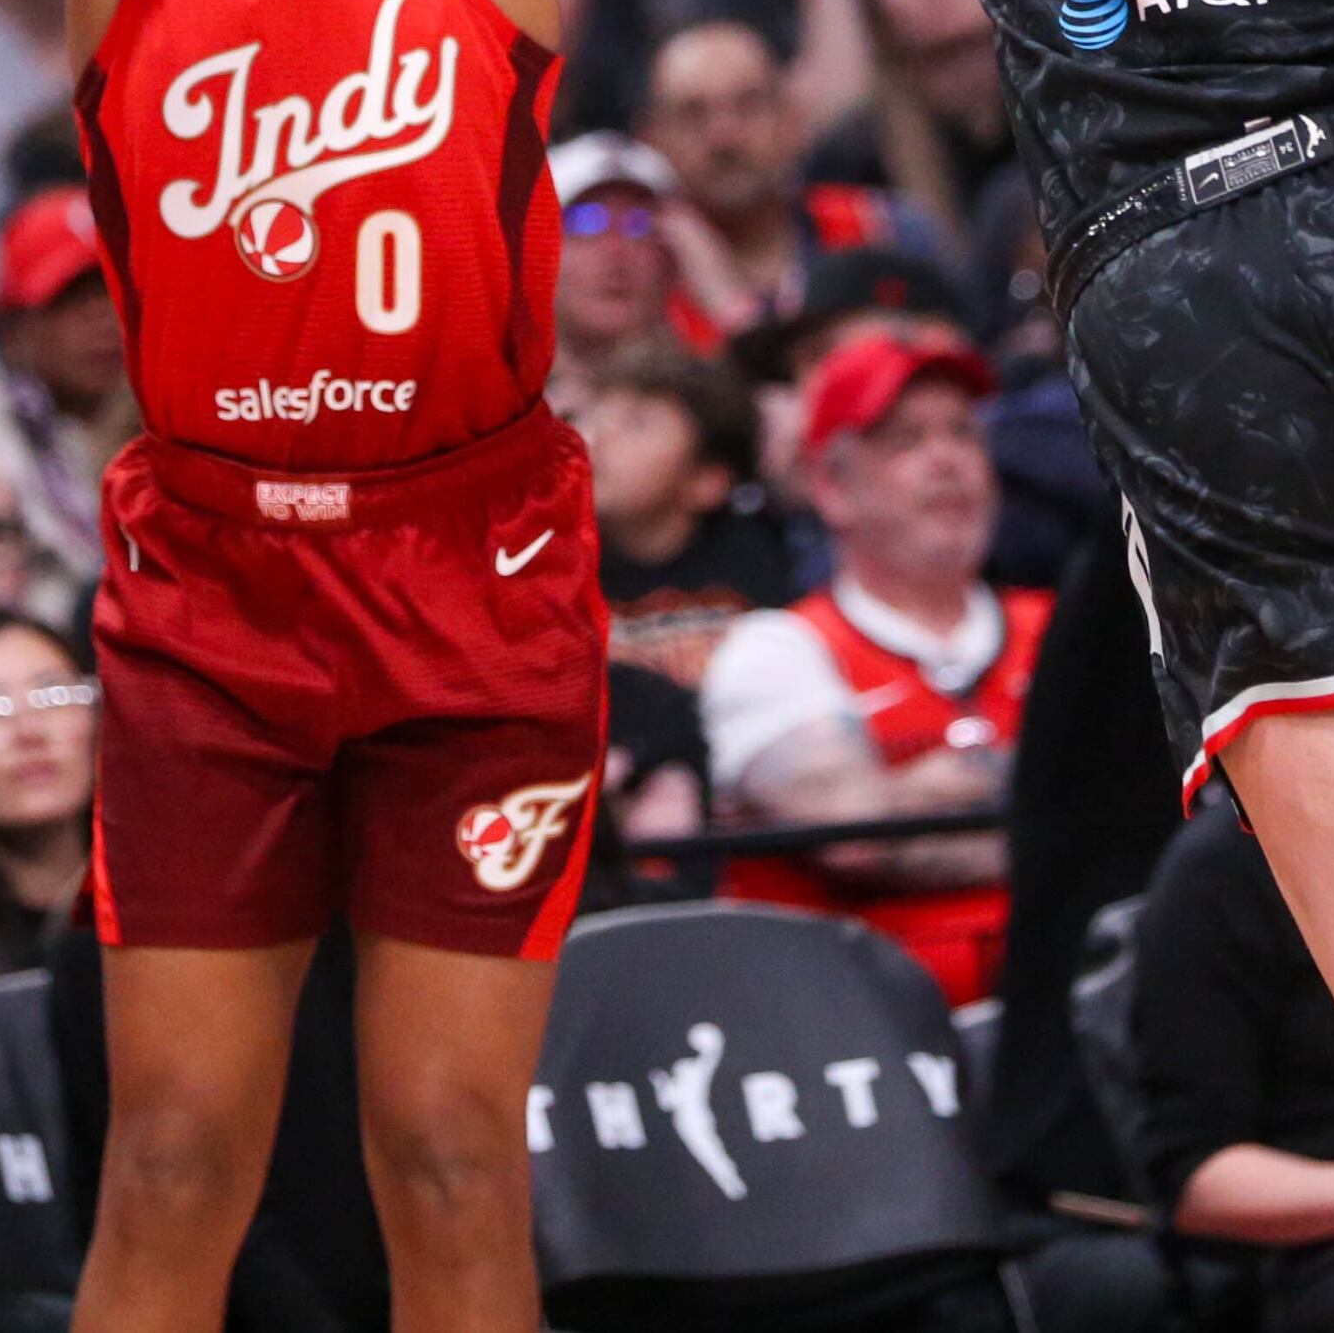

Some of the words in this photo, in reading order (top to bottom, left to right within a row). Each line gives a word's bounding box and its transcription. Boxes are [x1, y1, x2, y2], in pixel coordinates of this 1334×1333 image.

[355, 208, 423, 336] 0
[214, 368, 419, 426] salesforce
[255, 480, 350, 505] EXPECT
